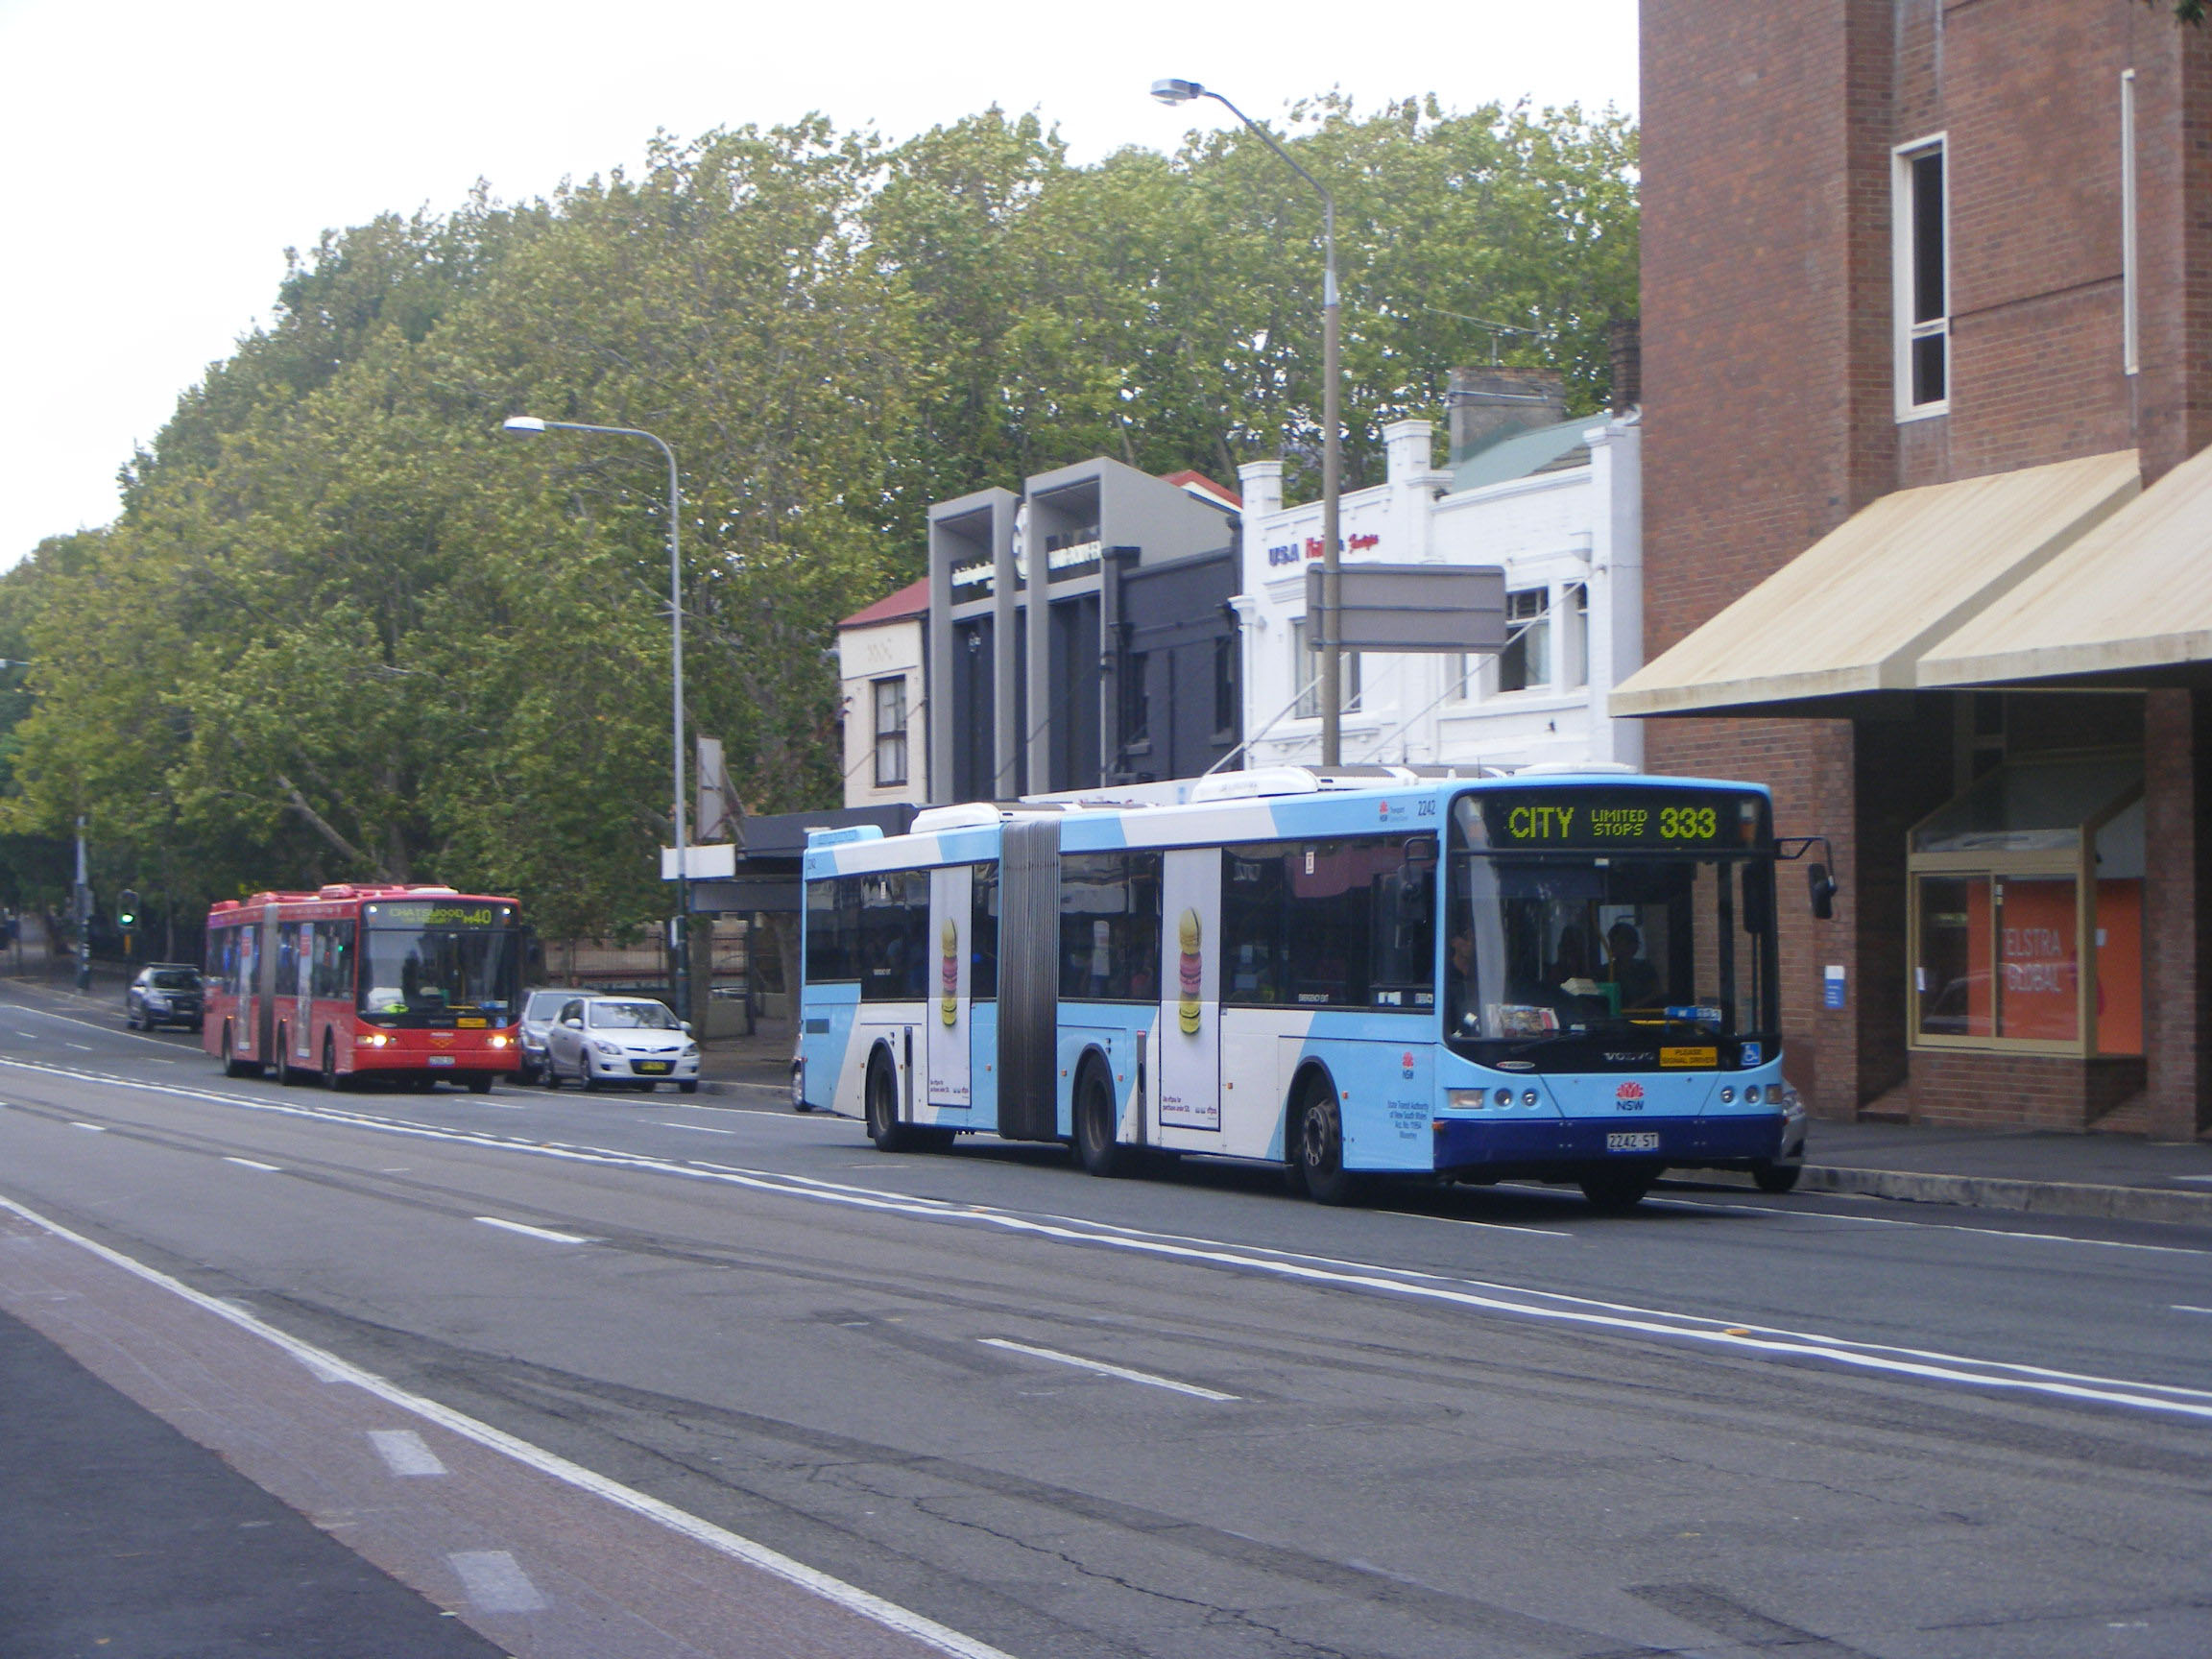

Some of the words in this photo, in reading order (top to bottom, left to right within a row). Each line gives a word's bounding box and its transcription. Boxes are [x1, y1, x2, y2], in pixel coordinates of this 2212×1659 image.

[1268, 543, 1300, 566] USA
[1418, 800, 1436, 816] 2242
[1508, 806, 1575, 838] CITY
[1591, 809, 1648, 824] LIMITED
[1659, 806, 1717, 838] 333
[1593, 823, 1645, 837] STOPS
[1604, 1052, 1655, 1062] VOLVO
[1616, 1100, 1645, 1111] NSW
[1609, 1134, 1637, 1147] 2242
